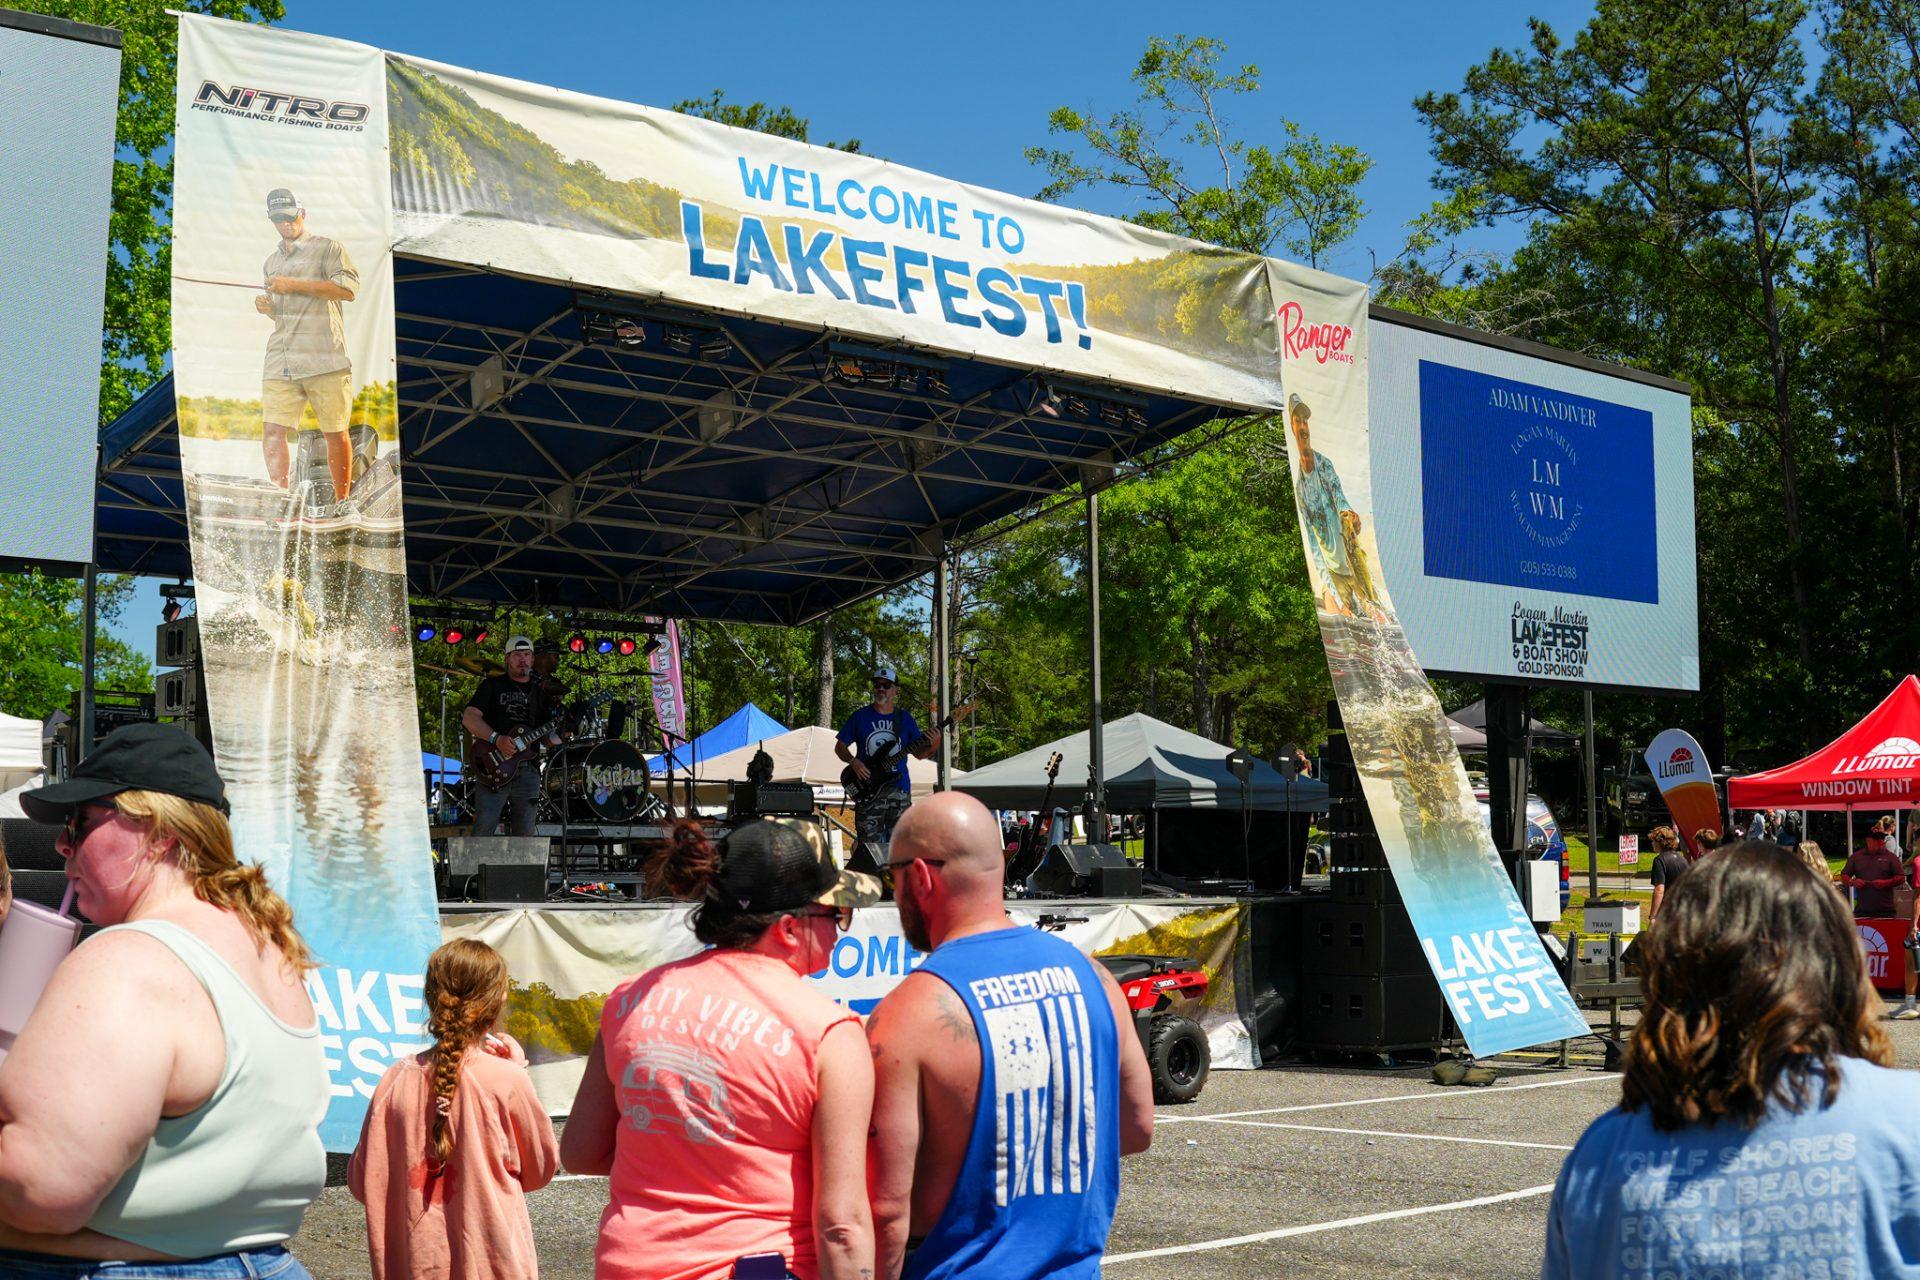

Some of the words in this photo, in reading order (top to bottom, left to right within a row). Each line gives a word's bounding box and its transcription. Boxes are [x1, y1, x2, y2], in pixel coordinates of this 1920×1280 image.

[191, 103, 275, 122] PERFORMANCE
[278, 117, 322, 129] FISHING
[325, 123, 363, 132] BOATS
[737, 157, 960, 241] WELCOME
[973, 209, 1024, 254] TO
[681, 200, 1093, 351] LAKEFEST!
[1277, 301, 1352, 364] Ranger
[1328, 351, 1354, 364] BOATS
[1489, 388, 1528, 413] ADAM
[1532, 396, 1597, 428] VANDIVER
[1511, 425, 1543, 455] LOGAN
[1545, 425, 1578, 465] MARTIN
[1520, 560, 1540, 576] (205)
[1511, 601, 1547, 622] Logan
[1550, 605, 1589, 626] Martin
[1513, 644, 1520, 659] &
[1523, 645, 1553, 661] BOAT
[1555, 648, 1588, 665] SHOW
[1518, 661, 1542, 674] GOLD
[1544, 663, 1584, 678] SPONSOR
[1658, 760, 1695, 779] LLumar
[1831, 755, 1920, 775] LLumar
[1801, 779, 1872, 797] WINDOW
[1878, 777, 1913, 795] TINT
[1422, 926, 1538, 981] LAKE
[302, 968, 426, 1035] AKE
[969, 966, 1081, 1009] FREEDOM
[1445, 969, 1553, 1024] FEST
[641, 1014, 741, 1051] DESTIN
[699, 993, 795, 1056] VIBES
[1623, 1148, 1709, 1178] GULF
[1718, 1132, 1857, 1174] SHORES
[1620, 1178, 1726, 1211] WEST
[1737, 1166, 1857, 1204] BEACH
[1620, 1212, 1702, 1243] FORT
[1711, 1200, 1858, 1237] MORGAN
